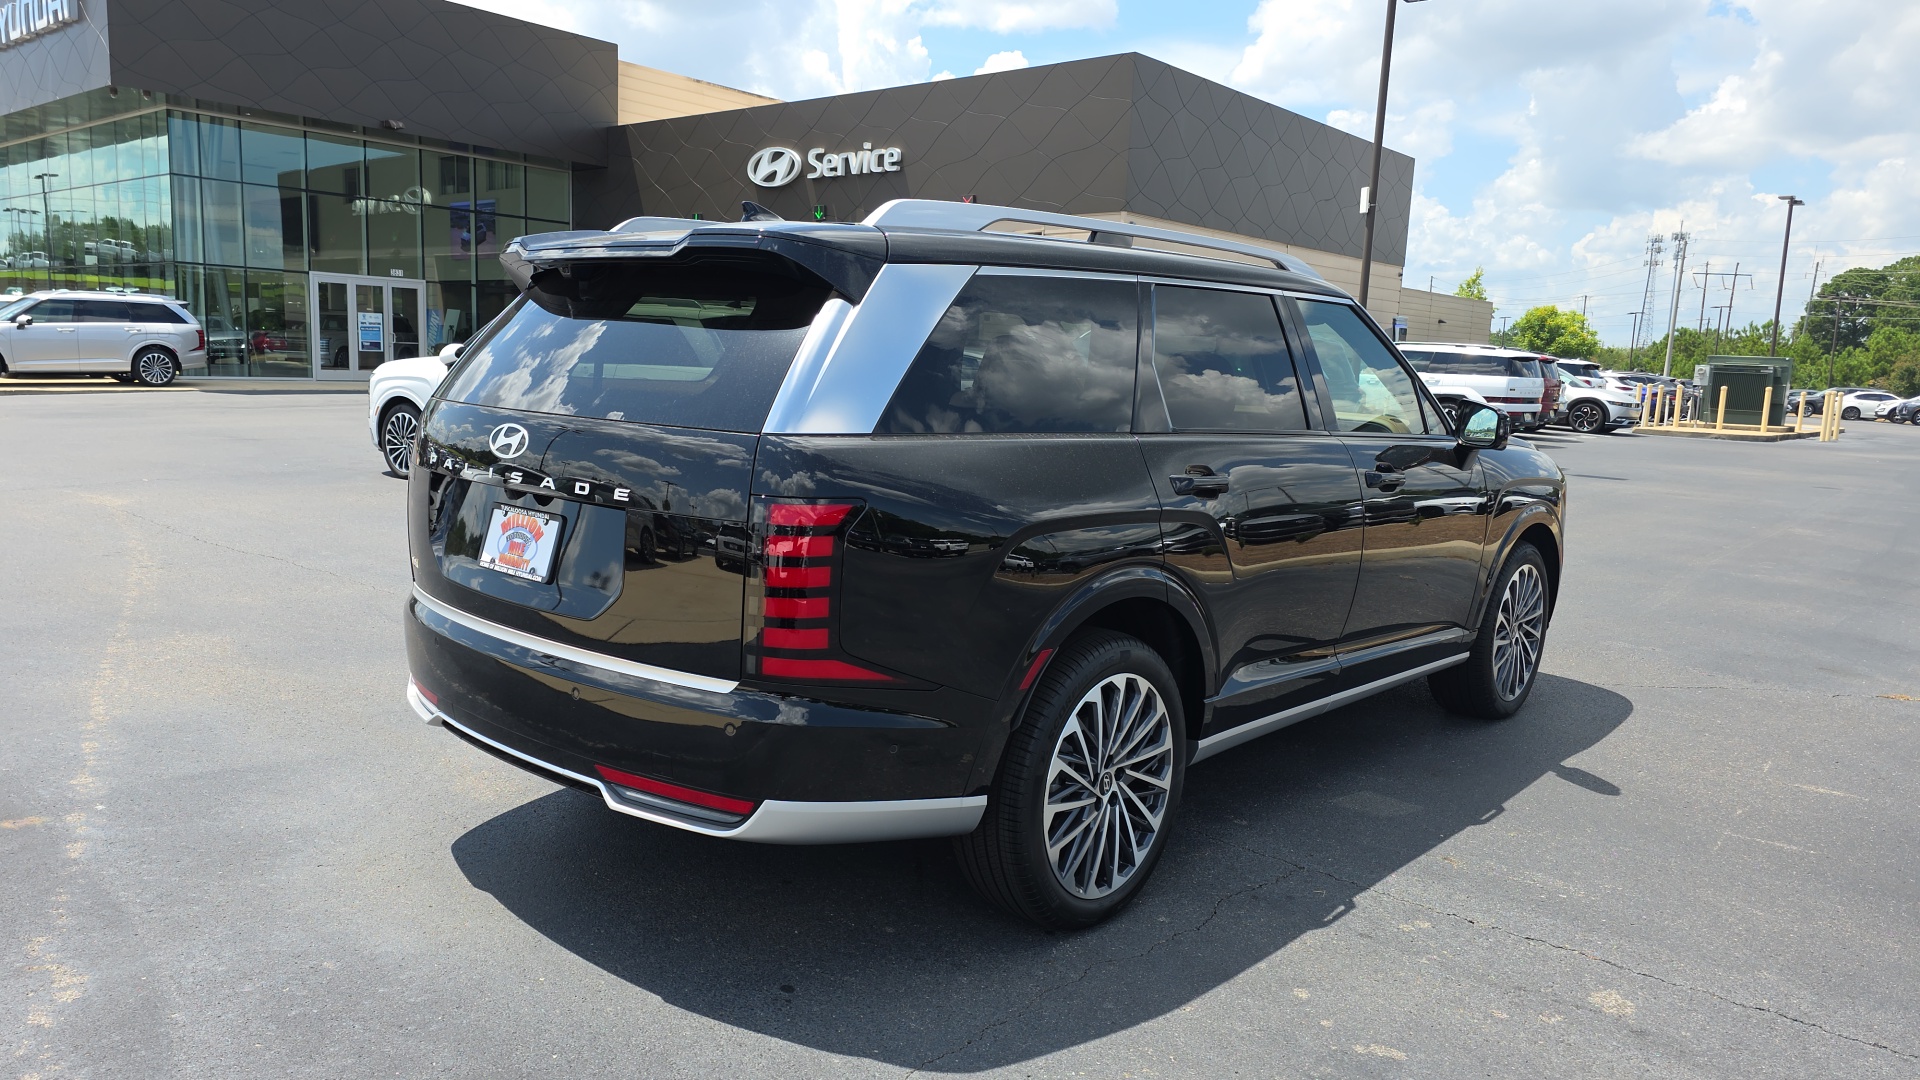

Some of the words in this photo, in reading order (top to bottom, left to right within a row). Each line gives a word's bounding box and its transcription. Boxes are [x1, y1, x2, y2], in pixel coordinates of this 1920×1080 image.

[807, 142, 902, 179] Service
[429, 452, 631, 501] PALISADE
[501, 505, 527, 516] TUSCALOOSA
[528, 510, 550, 519] HYUNDAI
[501, 513, 544, 543] MILLION
[508, 540, 527, 557] MILE
